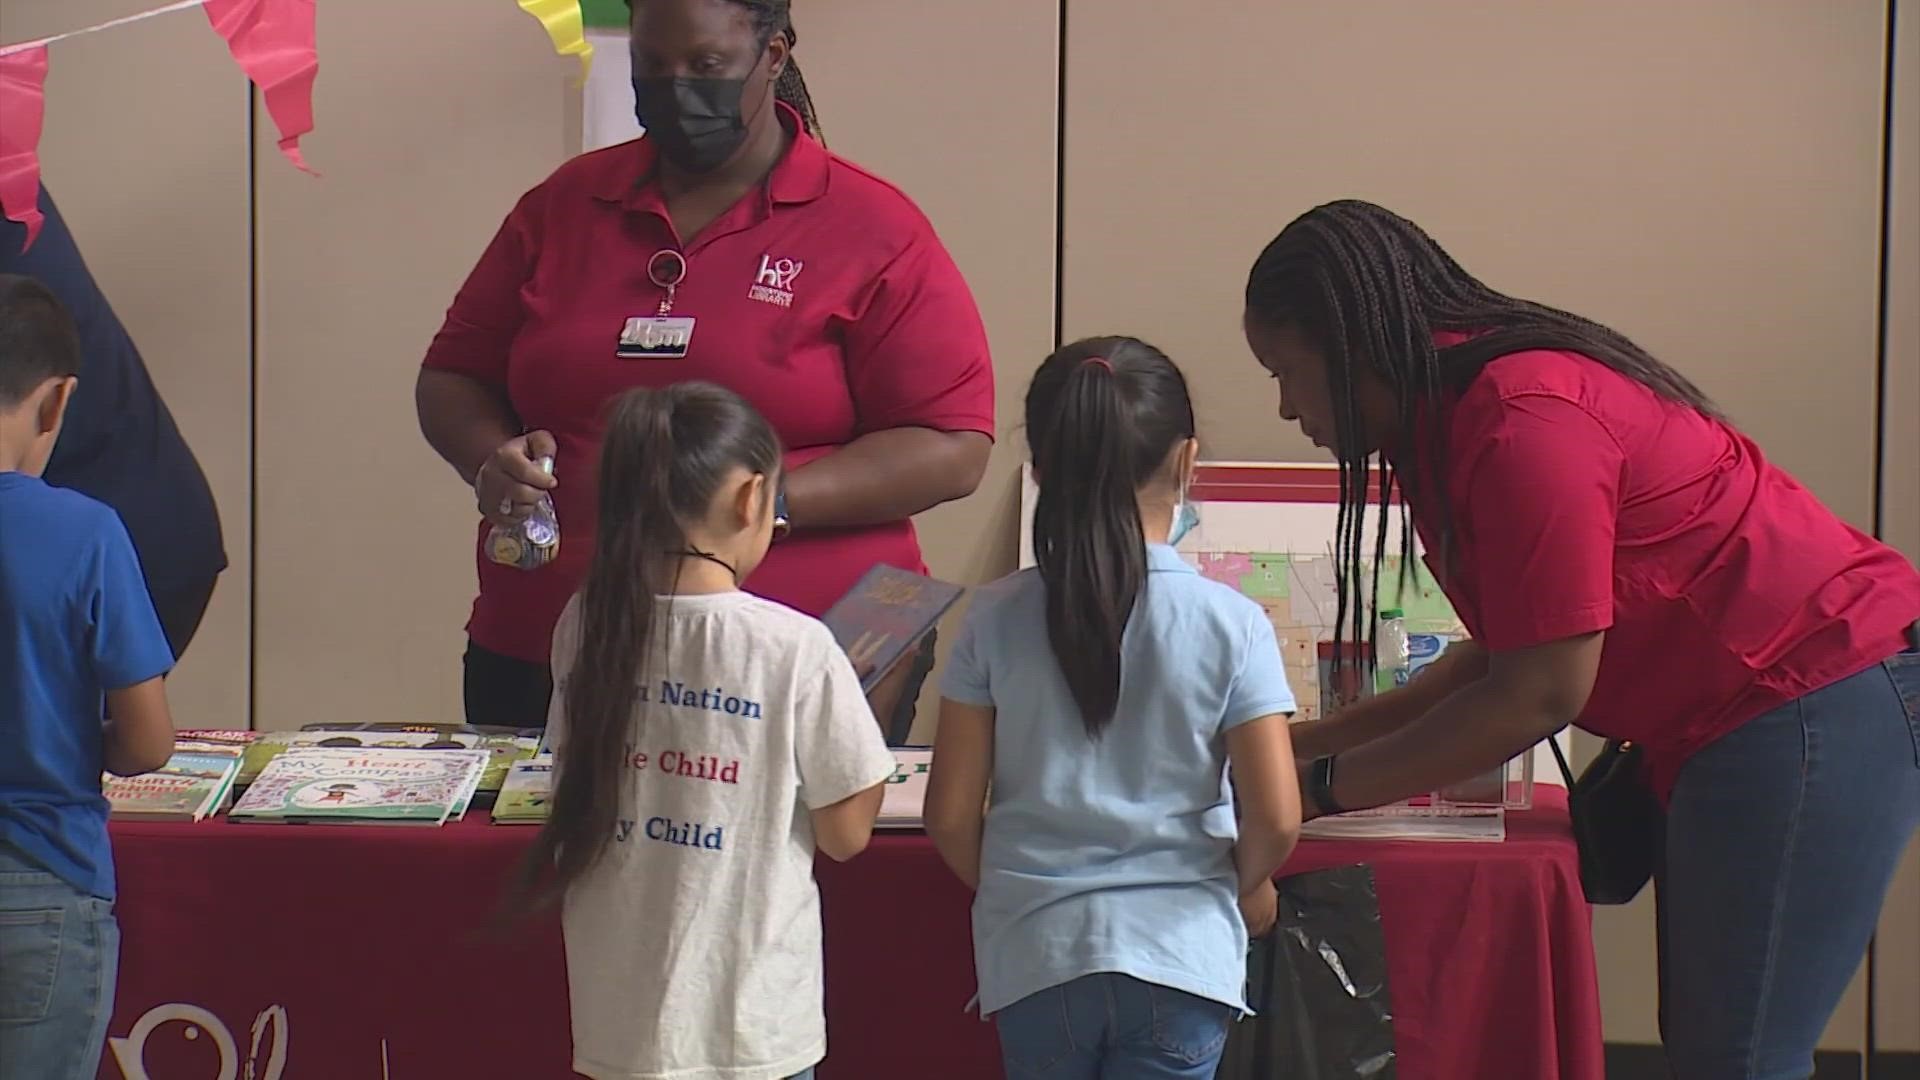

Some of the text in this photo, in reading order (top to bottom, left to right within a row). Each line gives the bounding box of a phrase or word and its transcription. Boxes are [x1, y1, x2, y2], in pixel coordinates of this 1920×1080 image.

[660, 680, 762, 719] Nation
[281, 759, 427, 769] My Heart
[658, 751, 739, 784] Child
[645, 816, 723, 850] Child
